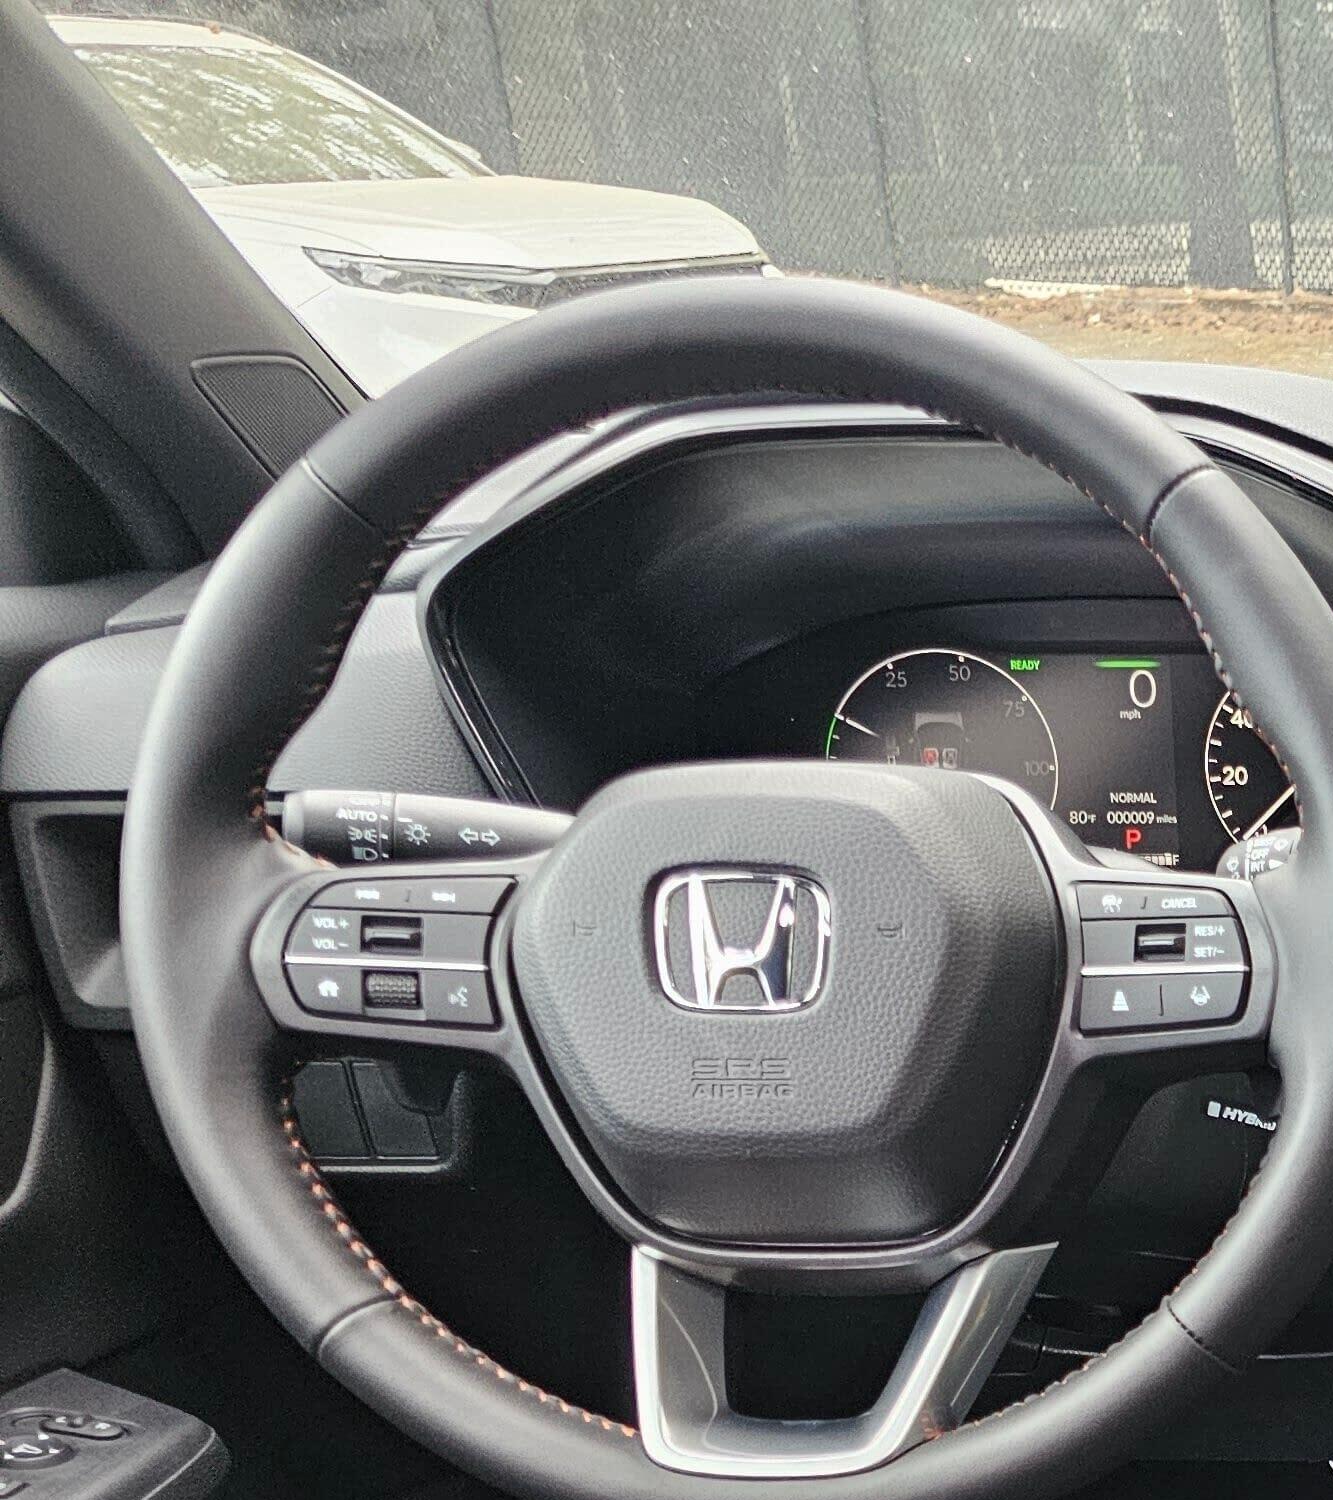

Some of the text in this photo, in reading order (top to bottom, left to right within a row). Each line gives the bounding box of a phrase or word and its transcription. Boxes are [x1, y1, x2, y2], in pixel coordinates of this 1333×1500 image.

[1010, 659, 1041, 671] READY
[885, 672, 908, 688] 25
[949, 666, 971, 681] 50
[1130, 669, 1156, 708] 0
[1003, 700, 1025, 717] 75
[1120, 708, 1141, 720] mph
[1024, 761, 1050, 776] 100
[1222, 766, 1248, 785] 20
[1109, 792, 1157, 804] NORMAL
[336, 808, 378, 822] AUTO
[1106, 811, 1155, 824] 000009
[1156, 814, 1177, 824] miles
[1126, 828, 1141, 849] P
[1161, 897, 1197, 909] CANCEL
[1194, 924, 1226, 937] RES/+
[691, 1057, 792, 1079] SRS
[692, 1083, 795, 1098] AIRBAG
